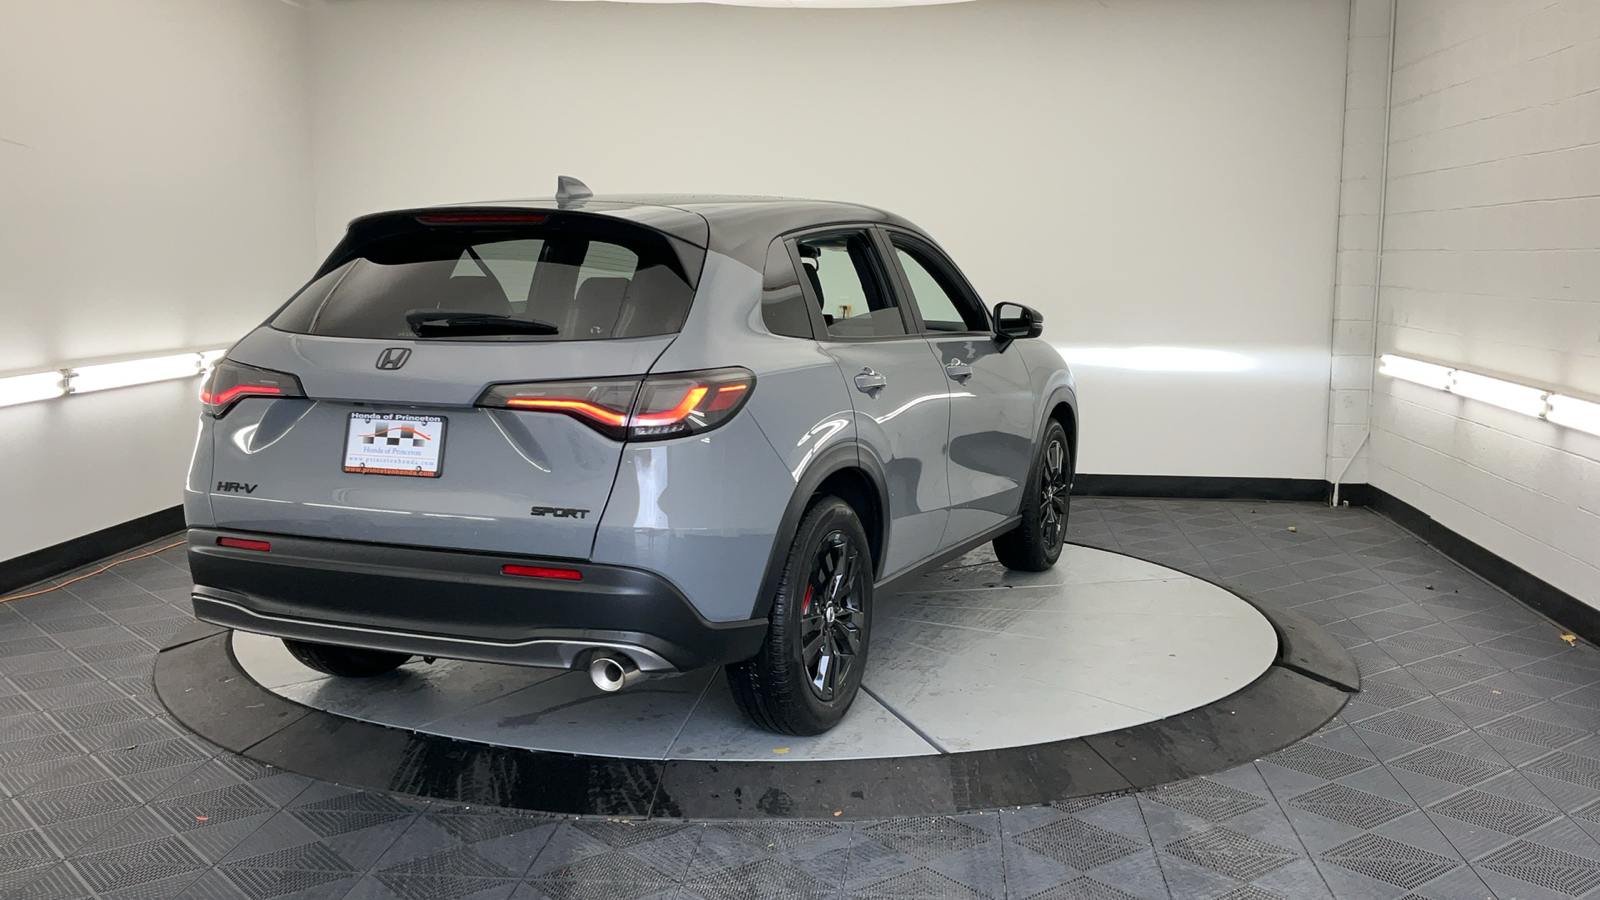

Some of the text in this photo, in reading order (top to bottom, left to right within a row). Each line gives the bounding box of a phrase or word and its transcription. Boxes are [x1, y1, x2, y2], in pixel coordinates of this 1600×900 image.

[351, 412, 381, 420] Honda
[395, 414, 441, 422] Princeton
[363, 446, 383, 454] Honda
[392, 448, 422, 456] Princeton
[345, 467, 435, 477] www.princetonhonda.com
[217, 481, 259, 494] HR-V
[530, 506, 591, 519] SPORT
